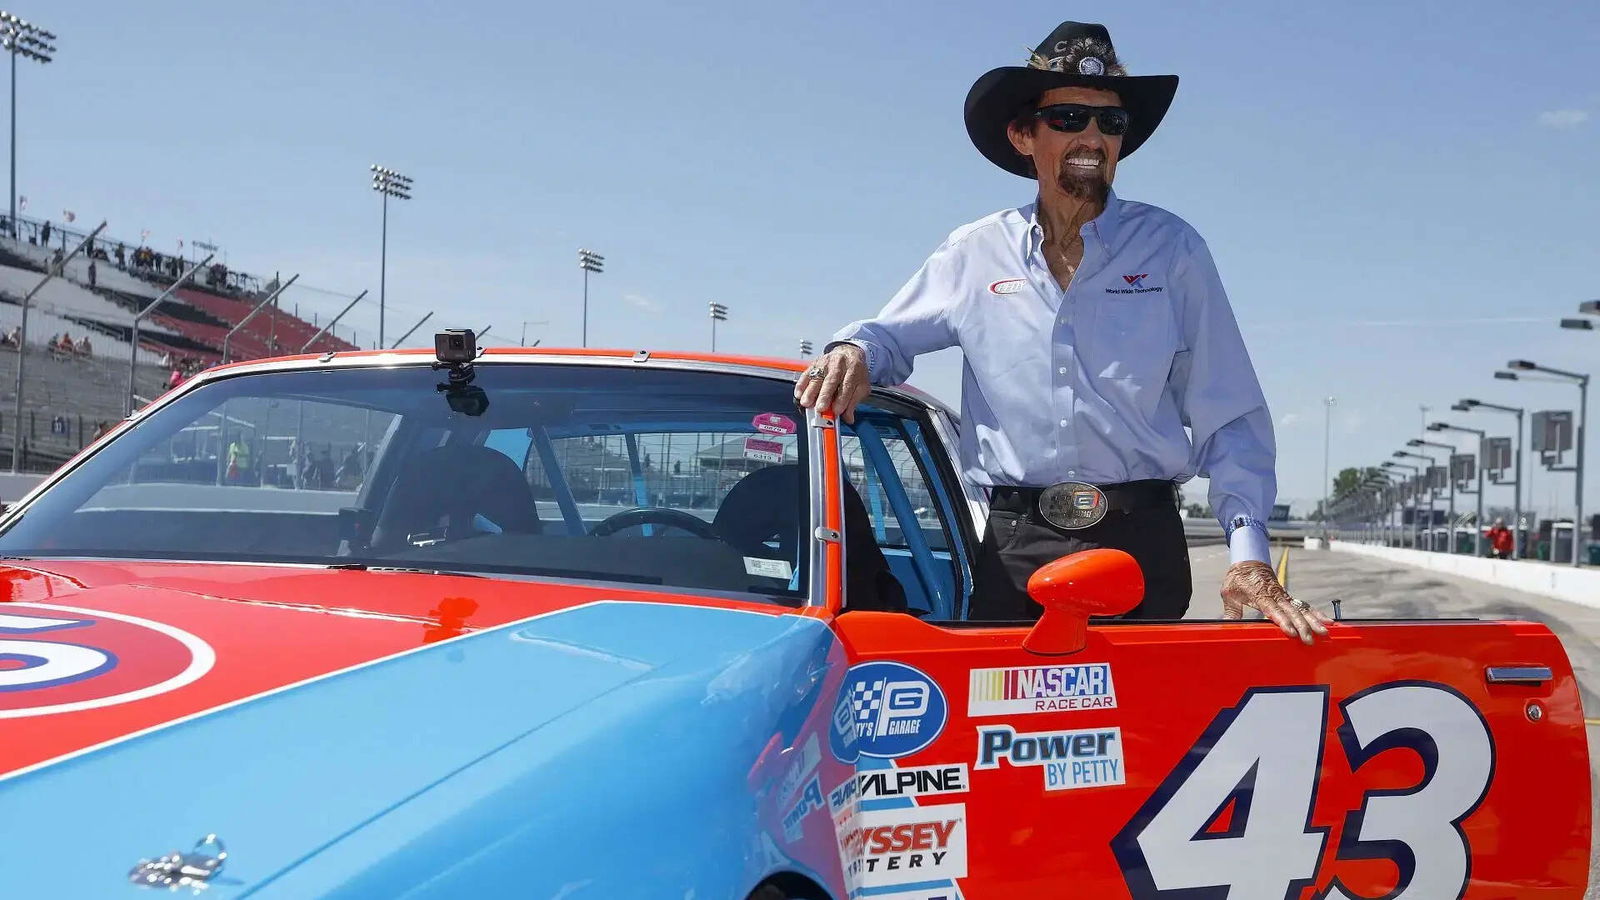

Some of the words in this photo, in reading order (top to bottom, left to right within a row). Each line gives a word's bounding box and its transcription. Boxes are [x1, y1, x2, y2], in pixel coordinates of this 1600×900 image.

[1016, 666, 1105, 699] NASCAR
[1035, 698, 1078, 711] RACE
[1081, 696, 1113, 708] CAR
[889, 719, 921, 735] GARAGE
[980, 729, 1116, 766] Power
[1047, 762, 1068, 787] BY
[1072, 758, 1119, 784] PETTY
[1110, 679, 1497, 900] 43
